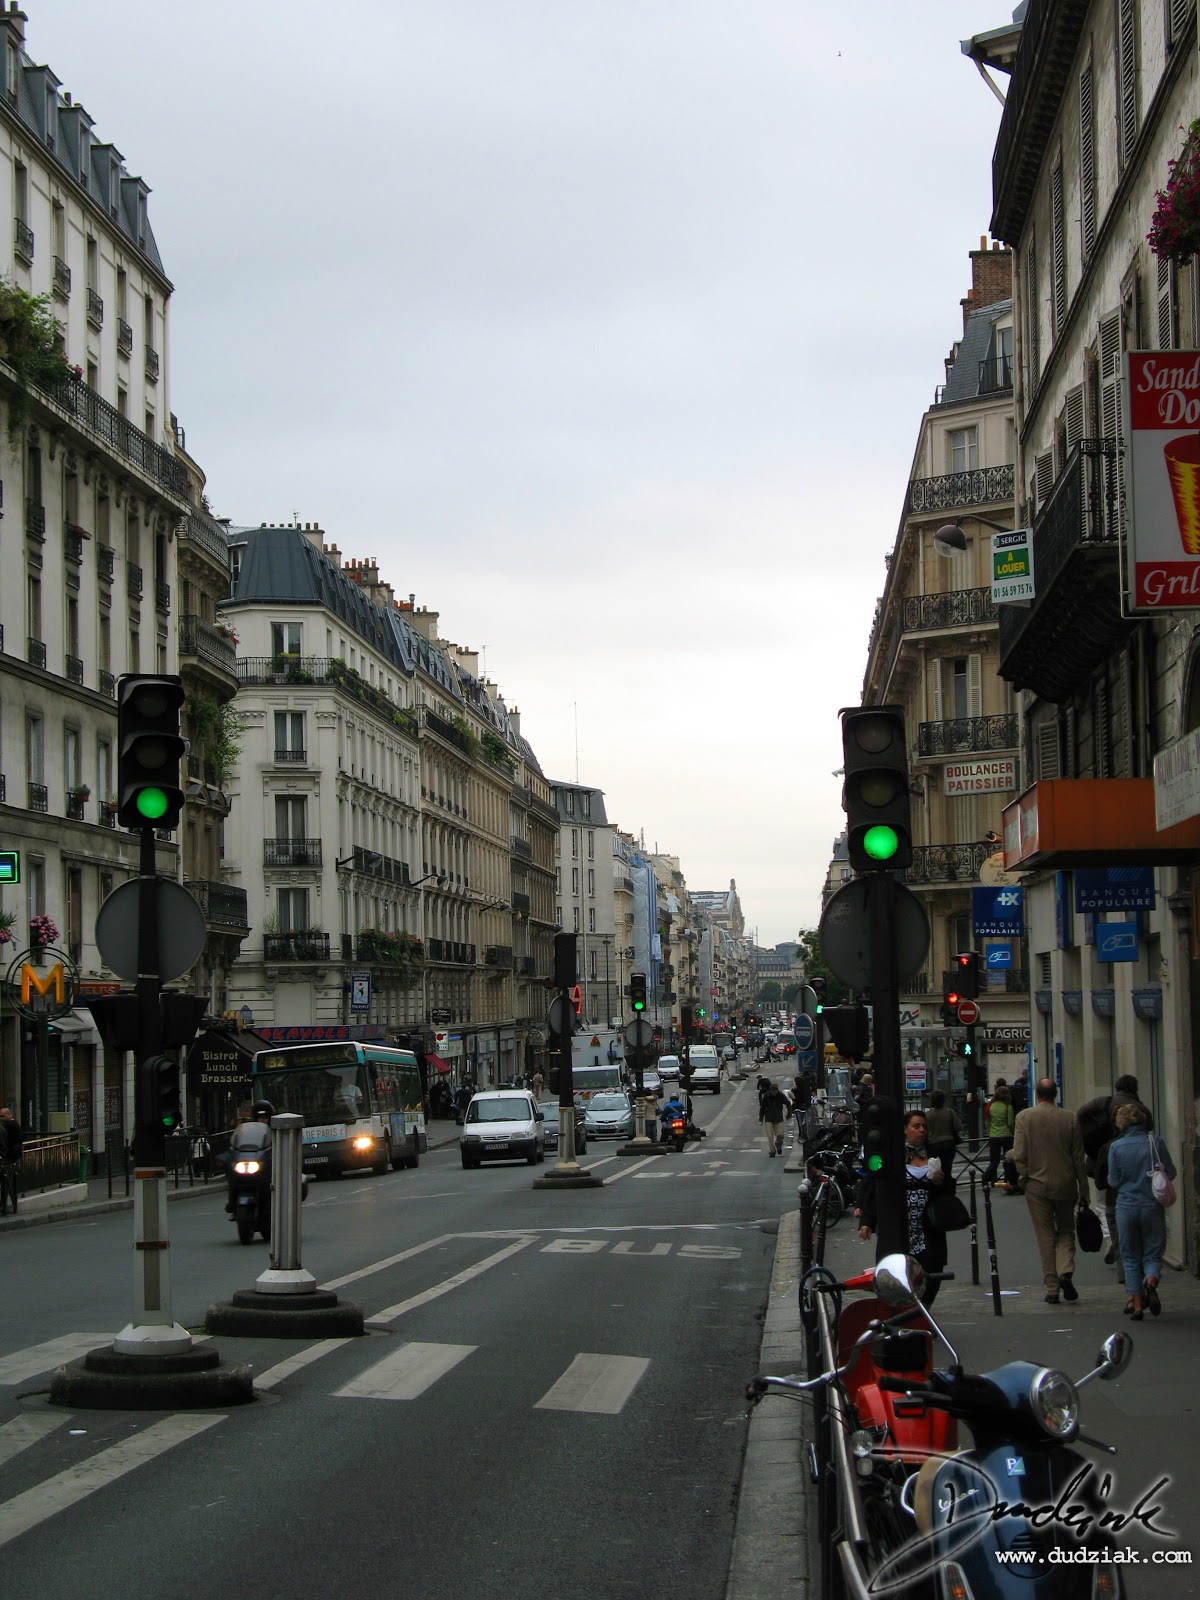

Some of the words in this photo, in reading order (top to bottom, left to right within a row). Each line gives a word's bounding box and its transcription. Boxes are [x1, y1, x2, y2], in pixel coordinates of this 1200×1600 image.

[1001, 534, 1026, 545] SERGIC
[1007, 552, 1014, 562] A
[997, 561, 1025, 575] LOUER
[946, 762, 1013, 778] BOULANGER
[948, 776, 1013, 793] PATISSIER
[1081, 887, 1151, 897] BANQUE
[1081, 898, 1151, 908] POPULAIRE
[21, 963, 65, 1005] M
[987, 1044, 1003, 1053] DE
[202, 1051, 239, 1061] Bistrot
[205, 1062, 238, 1072] Lunch
[305, 1130, 315, 1140] DE
[316, 1128, 338, 1139] PARIS
[539, 1238, 743, 1259] BUS
